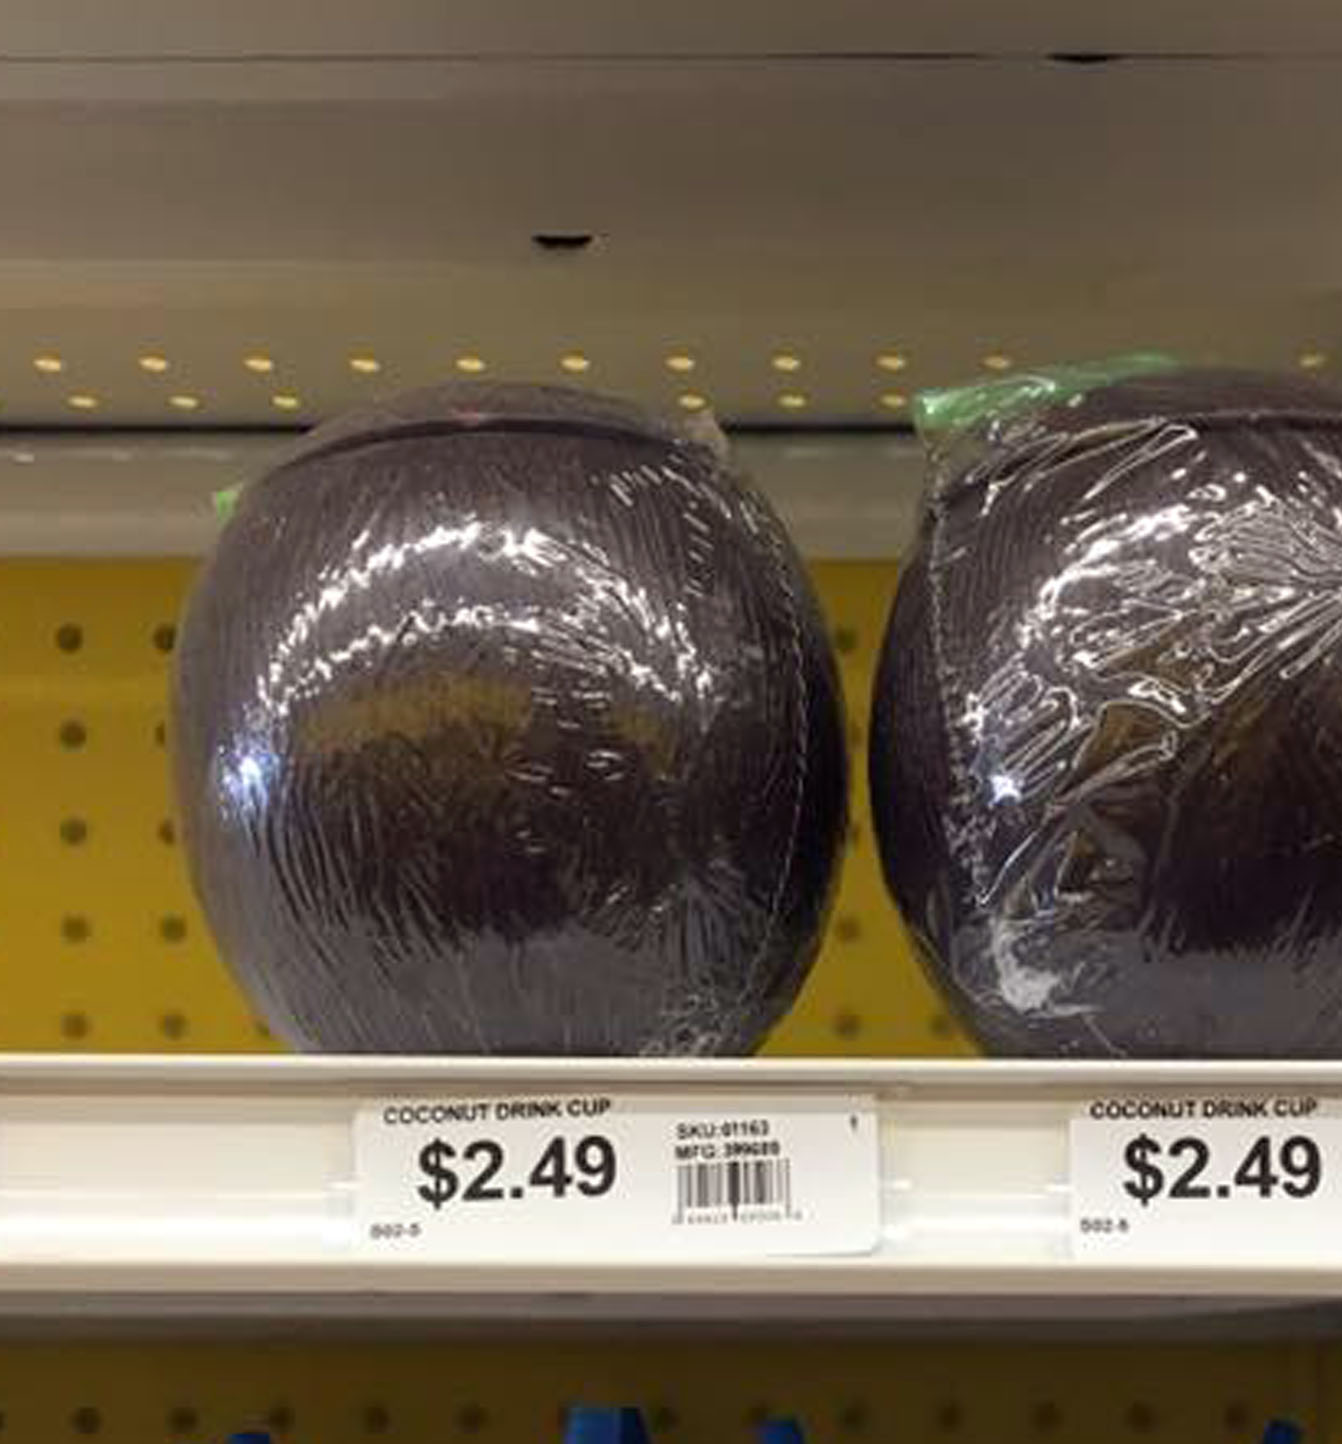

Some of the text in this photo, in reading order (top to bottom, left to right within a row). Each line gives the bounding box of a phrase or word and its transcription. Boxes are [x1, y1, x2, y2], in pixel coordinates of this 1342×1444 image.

[383, 1097, 612, 1124] COCONUT DRINK CUP
[1089, 1097, 1318, 1119] COCONUT DRINK CUP
[417, 1136, 617, 1211] $2.49
[1123, 1133, 1322, 1208] $2.49
